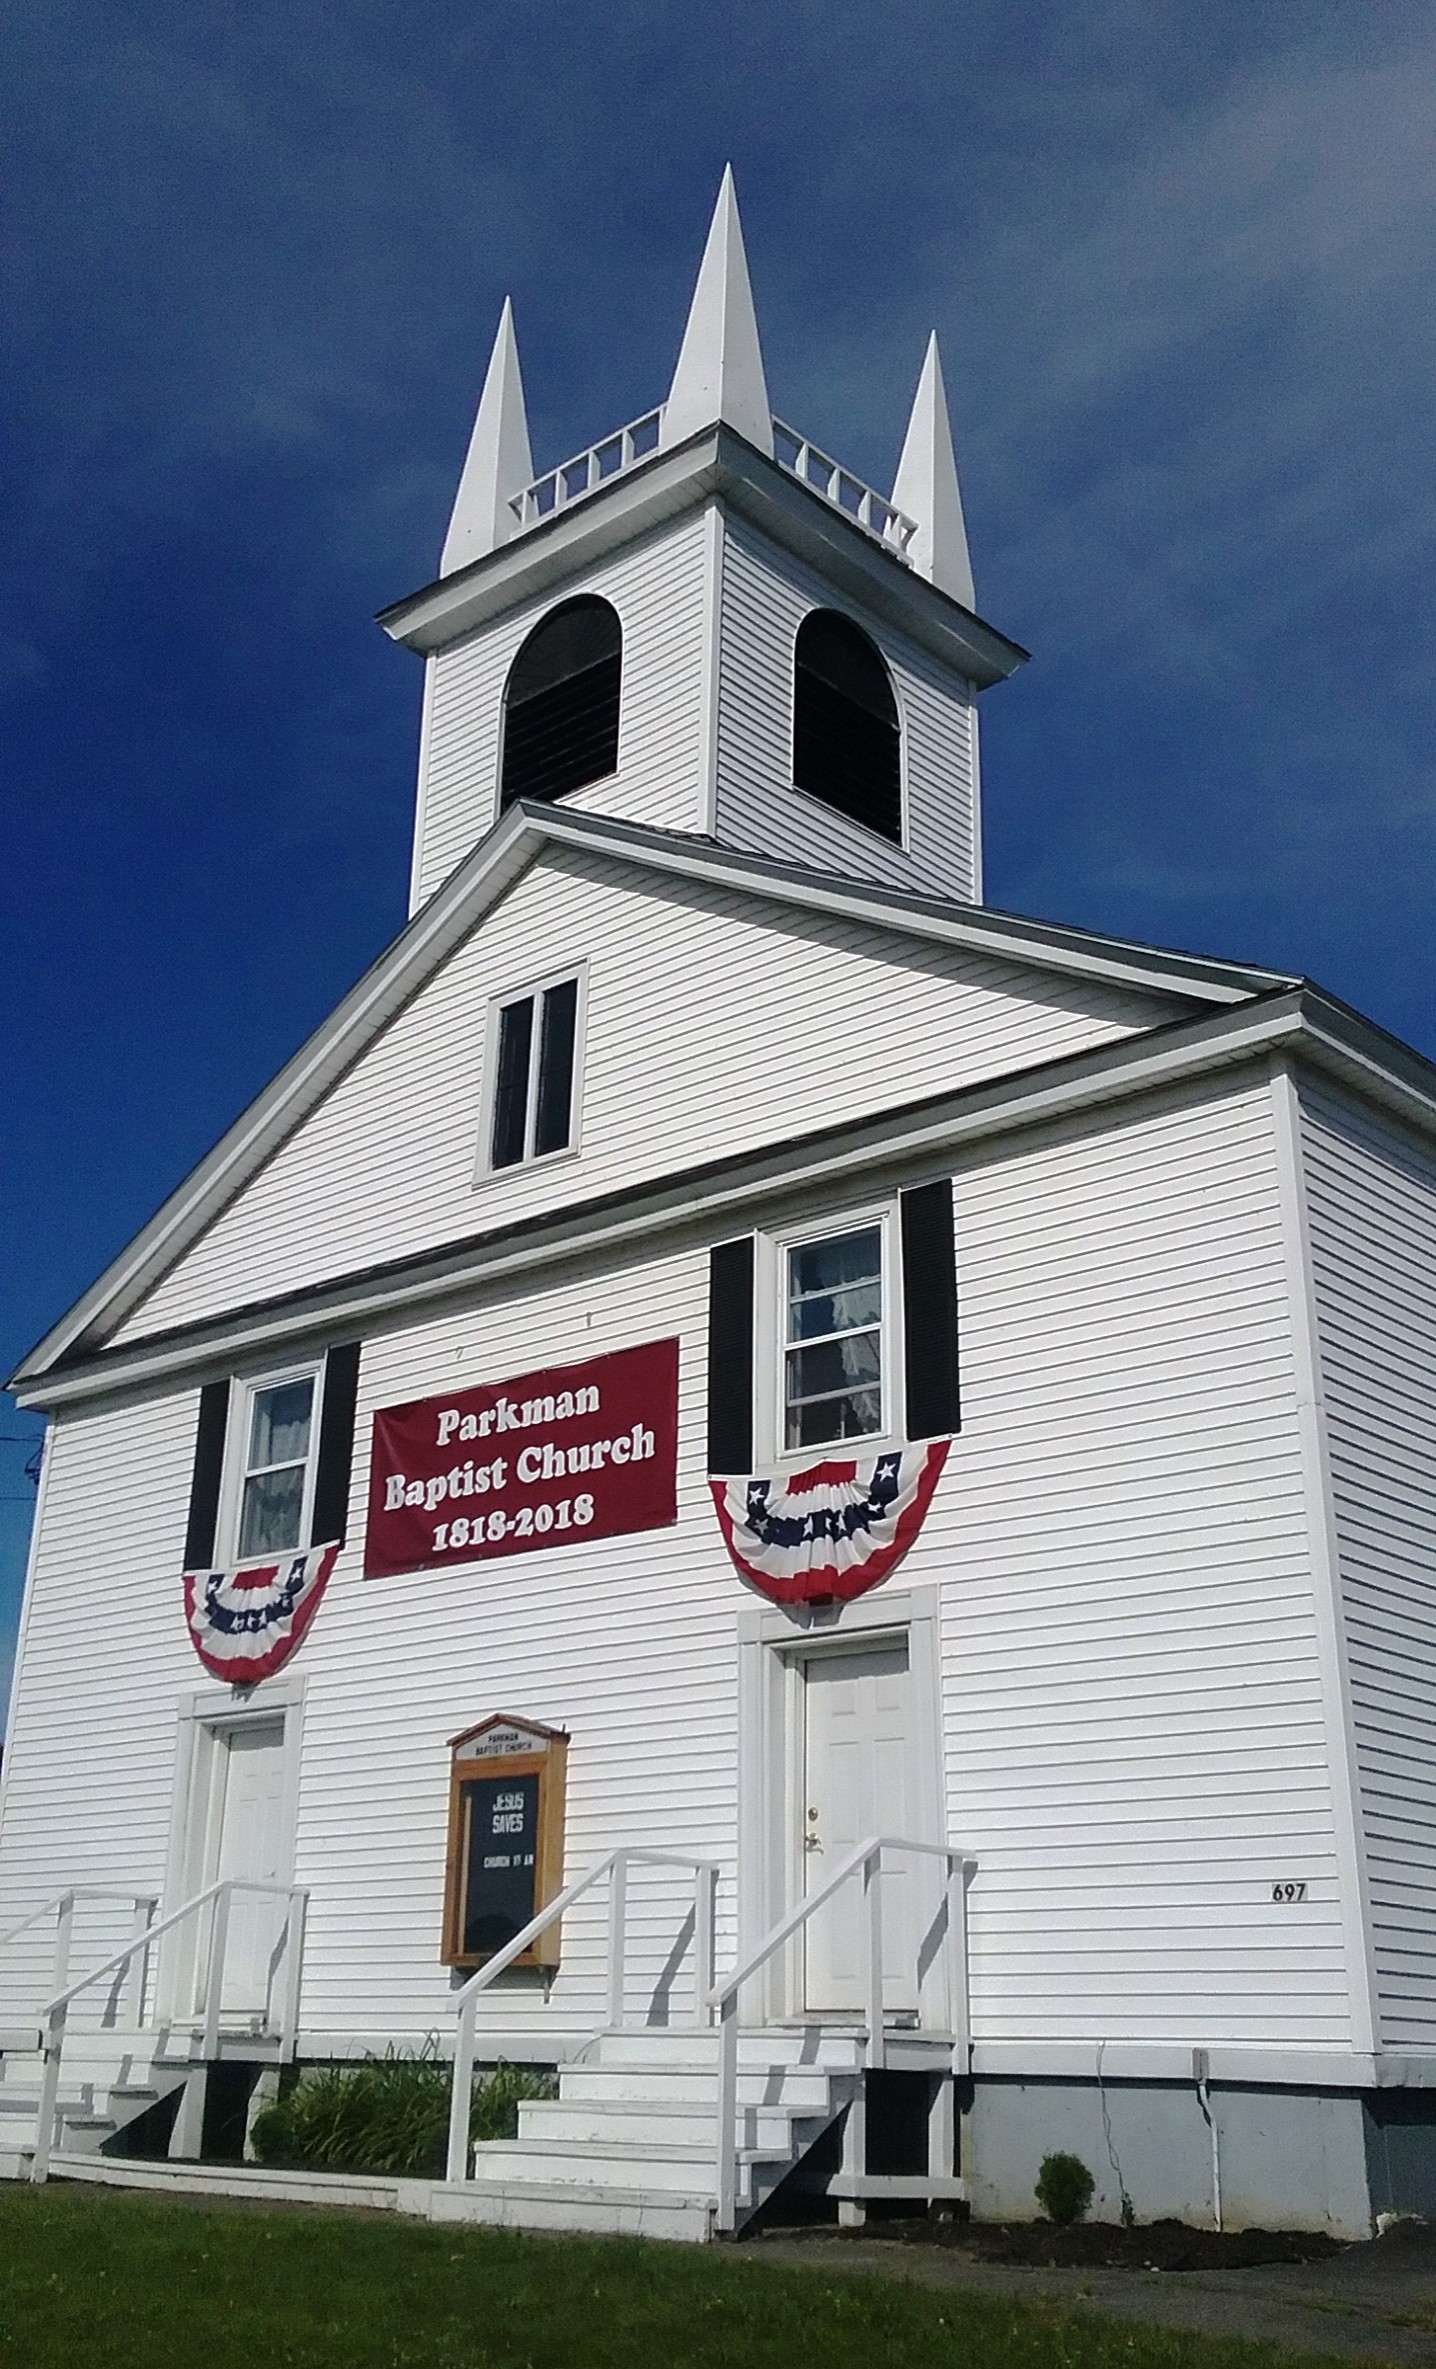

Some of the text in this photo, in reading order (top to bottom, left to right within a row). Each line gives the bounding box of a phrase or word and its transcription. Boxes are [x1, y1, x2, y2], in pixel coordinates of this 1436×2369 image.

[436, 1385, 600, 1446] Parkman
[384, 1423, 655, 1511] Baptist Church
[432, 1494, 595, 1551] 1818-2018
[476, 1741, 532, 1756] BAPTIST CHURCH
[492, 1792, 524, 1812] JESUS
[492, 1813, 524, 1834] SAVES
[1272, 1883, 1306, 1901] 697
